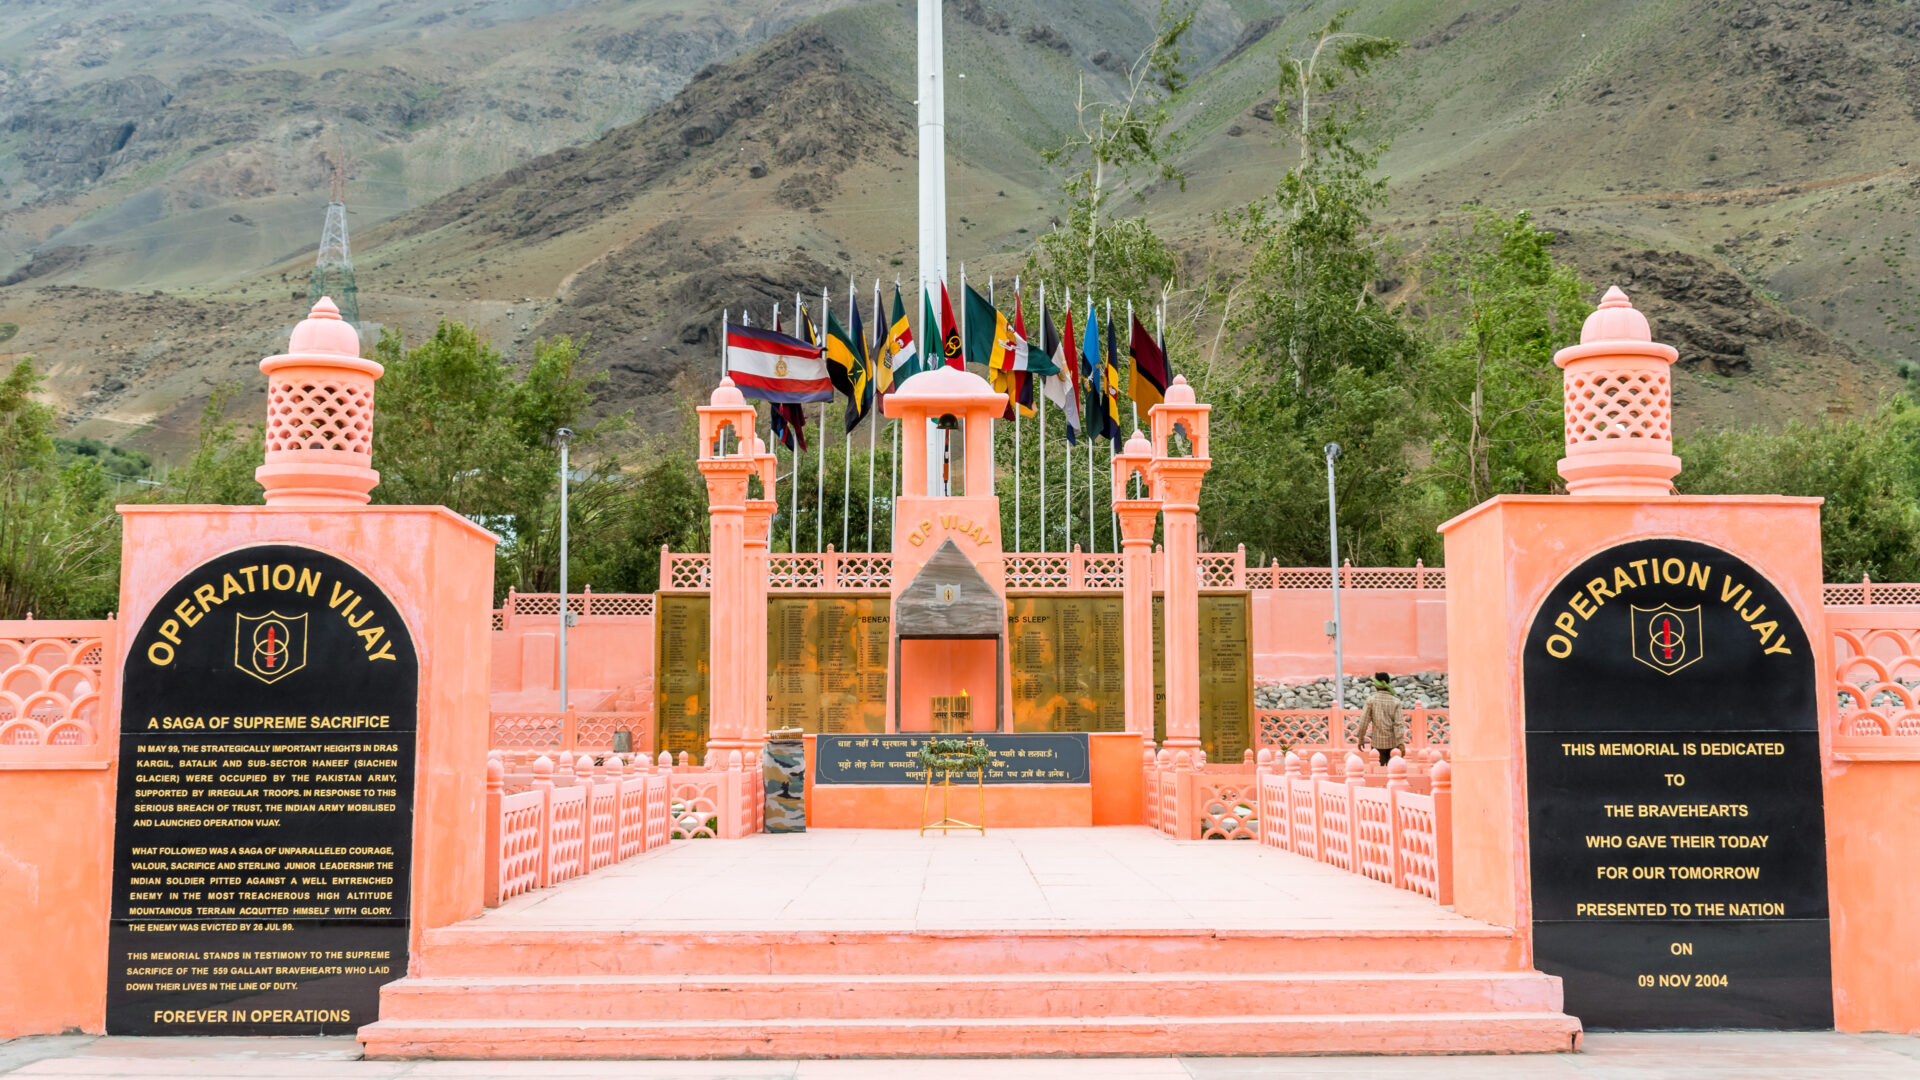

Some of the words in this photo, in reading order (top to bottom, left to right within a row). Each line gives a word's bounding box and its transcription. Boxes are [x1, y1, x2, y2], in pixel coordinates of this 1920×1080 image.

[908, 520, 932, 547] OP
[940, 514, 992, 547] VIJAY
[1545, 557, 1711, 659] OPERATION
[1720, 575, 1792, 655] VIJAY
[148, 564, 322, 666] OPERATION
[328, 580, 397, 662] VIJAY
[147, 717, 160, 729] A
[162, 716, 206, 730] SAGA
[208, 716, 230, 729] OF
[233, 716, 307, 729] SUPREME
[310, 715, 390, 729] SACRIFICE
[137, 745, 147, 753] IN
[147, 744, 167, 753] MAY
[181, 744, 199, 753] THE
[200, 744, 271, 753] STRATEGICALLY
[272, 744, 322, 753] IMPORTANT
[323, 744, 362, 753] HEIGHTS
[363, 744, 372, 752] IN
[373, 743, 399, 752] DRAS
[1561, 743, 1596, 756] THIS
[1599, 743, 1680, 756] MEMORIAL
[1682, 743, 1697, 756] IS
[1700, 742, 1785, 756] DEDICATED
[179, 759, 218, 768] BATALIK
[222, 759, 243, 768] AND
[247, 759, 307, 768] SUB-SECTOR
[312, 759, 350, 768] HANEEF
[354, 759, 398, 769] (SIACHEN
[135, 774, 180, 784] GLACIER)
[185, 774, 214, 783] WERE
[219, 774, 267, 783] OCCUPIED
[272, 774, 286, 783] BY
[291, 774, 310, 782] THE
[315, 774, 362, 782] PAKISTAN
[1664, 773, 1685, 787] TO
[135, 789, 189, 798] SUPPORTED
[192, 789, 205, 797] BY
[207, 789, 259, 797] IRREGULAR
[303, 789, 312, 797] IN
[313, 789, 362, 797] RESPONSE
[363, 789, 376, 797] TO
[376, 788, 397, 797] THIS
[134, 804, 175, 812] SERIOUS
[176, 804, 215, 812] BREACH
[216, 804, 230, 812] OF
[264, 804, 283, 812] THE
[285, 804, 316, 812] INDIAN
[317, 803, 345, 812] ARMY
[347, 803, 396, 812] MOBILISED
[1603, 804, 1635, 818] THE
[1638, 804, 1749, 818] BRAVEHEARTS
[133, 819, 153, 827] AND
[154, 819, 202, 827] LAUNCHED
[203, 818, 254, 827] OPERATION
[1585, 835, 1623, 849] WHO
[1626, 835, 1667, 849] GAVE
[1670, 835, 1716, 849] THEIR
[1718, 835, 1769, 849] TODAY
[132, 847, 158, 855] WHAT
[159, 847, 208, 855] FOLLOWED
[208, 847, 229, 855] WAS
[230, 847, 237, 855] A
[238, 847, 263, 855] SAGA
[264, 846, 277, 855] OF
[278, 846, 347, 855] UNPARALLELED
[170, 862, 216, 870] SACRIFICE
[217, 862, 237, 870] AND
[237, 861, 281, 870] STERLING
[284, 862, 316, 870] JUNIOR
[376, 861, 394, 870] THE
[1597, 866, 1629, 880] FOR
[1632, 866, 1666, 880] OUR
[1668, 866, 1760, 880] TOMORROW
[130, 877, 162, 885] INDIAN
[166, 877, 205, 885] SOLDIER
[209, 877, 242, 885] PITTED
[246, 876, 286, 885] AGAINST
[290, 877, 298, 885] A
[301, 876, 328, 885] WELL
[332, 876, 394, 885] ENTRENCHED
[129, 892, 163, 901] ENEMY
[169, 892, 179, 900] IN
[182, 892, 201, 900] THE
[207, 891, 235, 900] MOST
[238, 891, 311, 900] TREACHEROUS
[316, 891, 340, 900] HIGH
[346, 891, 393, 900] ALTITUDE
[129, 907, 193, 916] MOUNTAINOUS
[196, 907, 236, 915] TERRAIN
[239, 907, 289, 915] ACQUITTED
[292, 906, 330, 915] HIMSELF
[333, 907, 357, 915] WITH
[1576, 903, 1667, 916] PRESENTED
[1670, 903, 1692, 916] TO
[1694, 903, 1725, 916] THE
[1728, 902, 1785, 916] NATION
[128, 923, 146, 932] THE
[147, 923, 178, 932] ENEMY
[179, 923, 199, 932] WAS
[200, 923, 238, 932] EVICTED
[239, 923, 252, 931] BY
[253, 923, 264, 931] 26
[264, 923, 281, 931] JUL
[1670, 942, 1693, 956] ON
[127, 952, 148, 961] THIS
[150, 952, 201, 960] MEMORIAL
[203, 951, 240, 960] STANDS
[242, 951, 252, 960] IN
[254, 951, 308, 960] TESTIMONY
[309, 951, 323, 960] TO
[324, 951, 343, 959] THE
[345, 950, 390, 959] SUPREME
[126, 967, 174, 976] SACRIFICE
[175, 967, 189, 975] OF
[191, 967, 209, 975] THE
[213, 967, 229, 975] 559
[230, 966, 274, 975] GALLANT
[275, 966, 343, 975] BRAVEHEARTS
[344, 966, 367, 975] WHO
[368, 966, 390, 974] LAID
[1637, 974, 1655, 988] 09
[1658, 974, 1692, 988] NOV
[1694, 973, 1729, 988] 2004
[154, 1009, 228, 1024] FOREVER
[232, 1009, 247, 1023] IN
[250, 1009, 351, 1023] OPERATIONS
